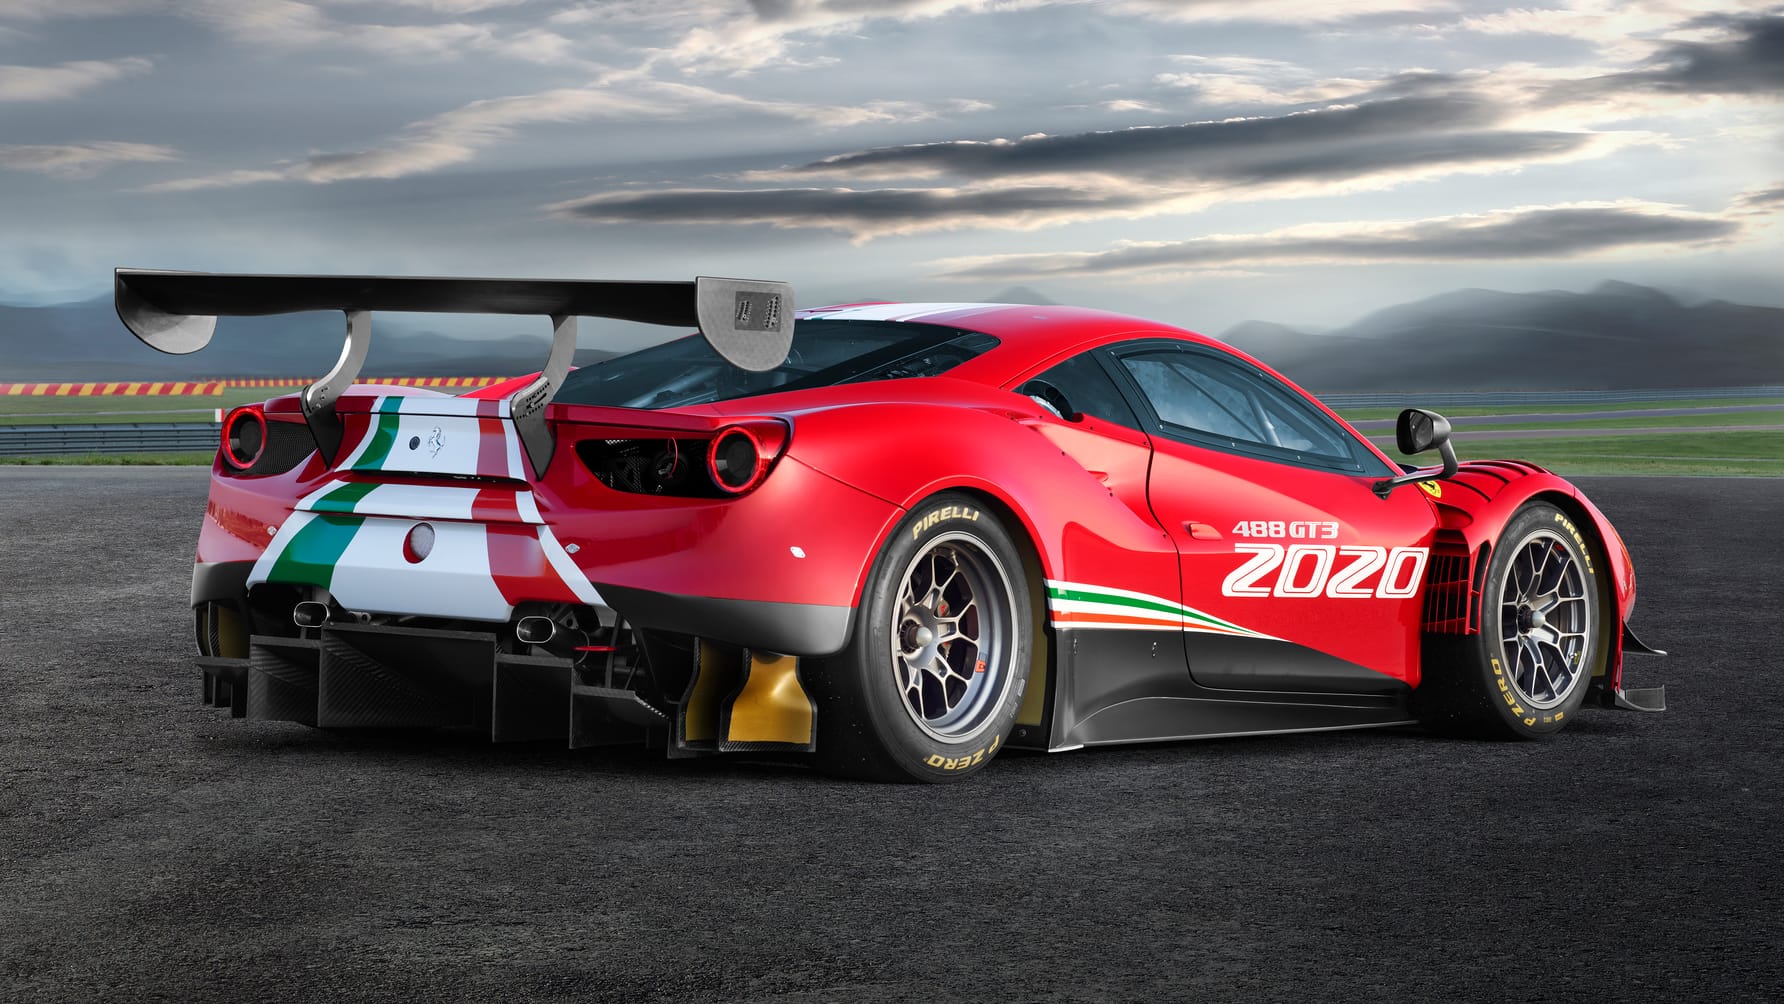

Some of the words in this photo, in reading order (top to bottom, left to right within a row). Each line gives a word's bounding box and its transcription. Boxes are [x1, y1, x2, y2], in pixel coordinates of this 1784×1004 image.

[912, 506, 980, 540] PIRELLI
[1232, 520, 1286, 538] 488
[1289, 521, 1339, 539] GT3
[1554, 513, 1595, 574] PIRELLI
[1221, 543, 1430, 599] 2020
[1491, 658, 1524, 717] ZERO
[1523, 717, 1537, 727] P
[988, 734, 1000, 754] P
[926, 748, 986, 770] ZERO
